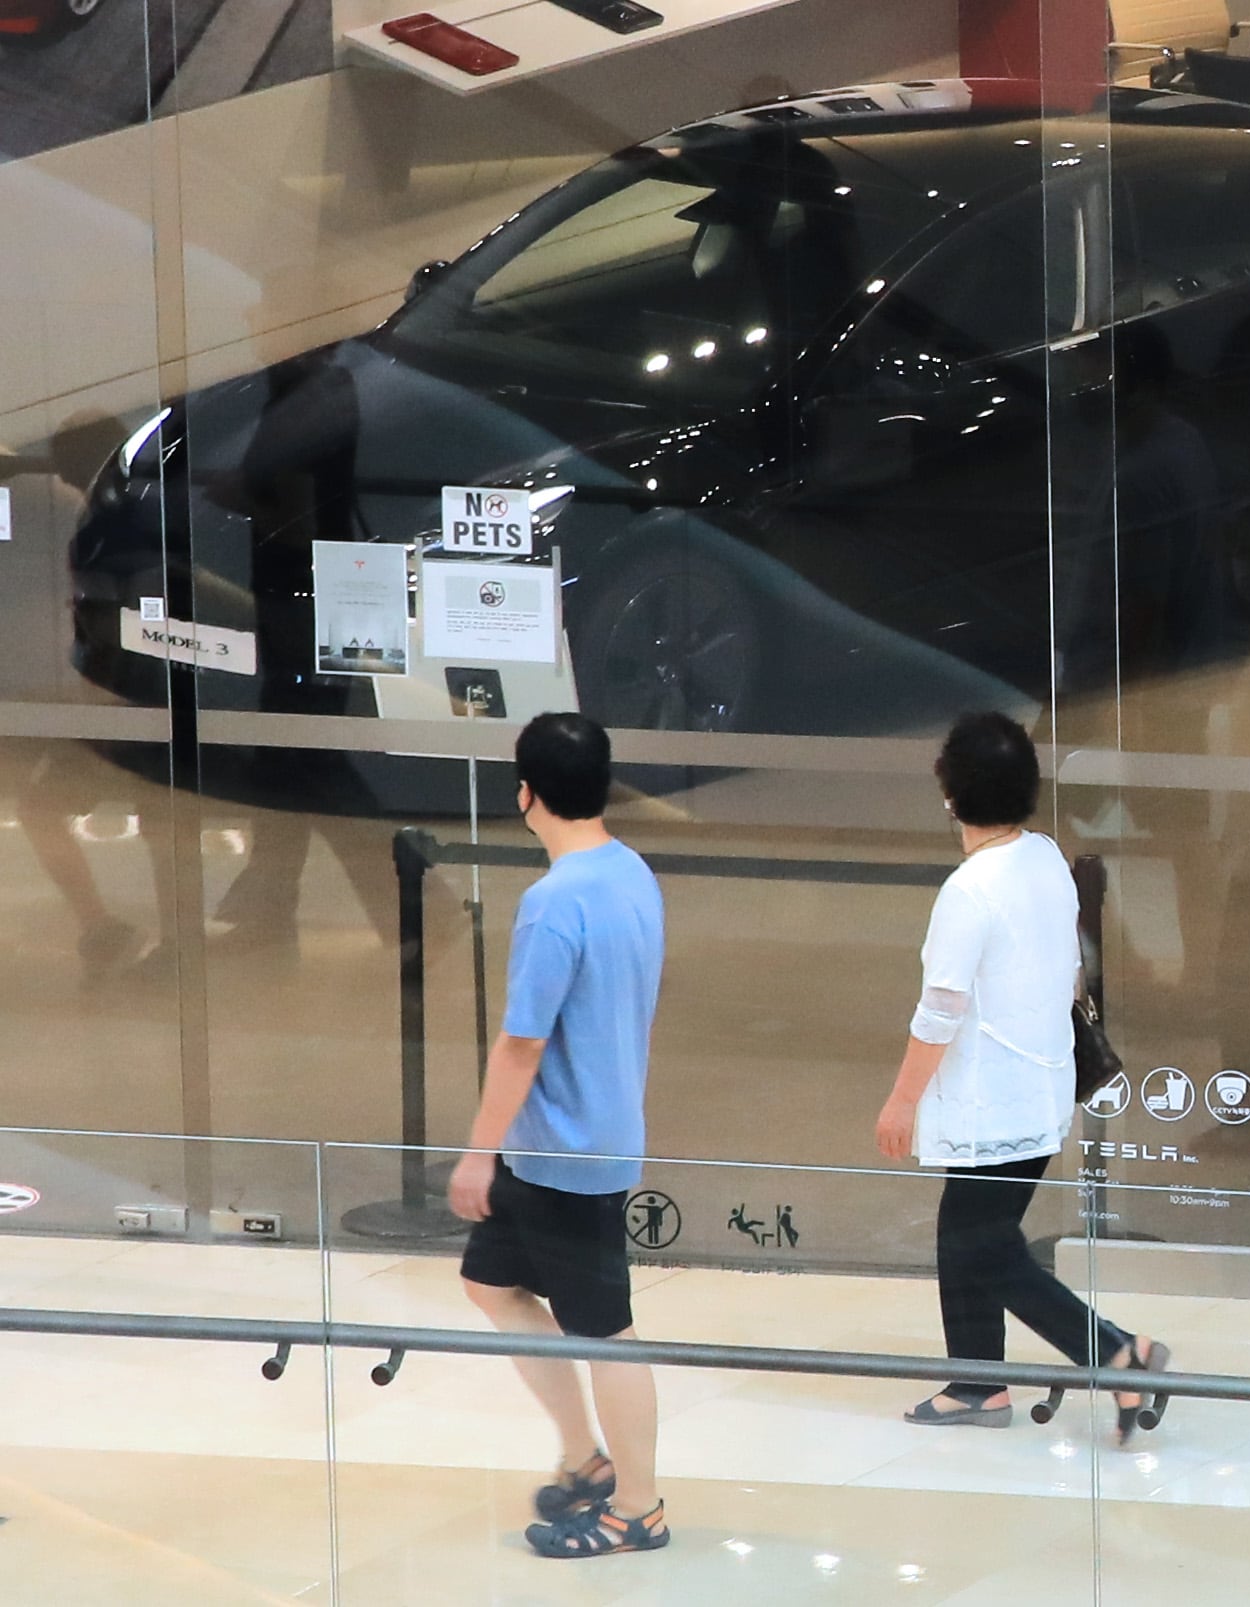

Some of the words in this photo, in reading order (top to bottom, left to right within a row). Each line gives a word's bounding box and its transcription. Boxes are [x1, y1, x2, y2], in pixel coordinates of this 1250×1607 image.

[453, 521, 522, 548] PETS
[142, 628, 209, 653] MODEL
[215, 643, 229, 656] 3
[1078, 1140, 1178, 1162] TESLA
[1078, 1167, 1108, 1178] SALES
